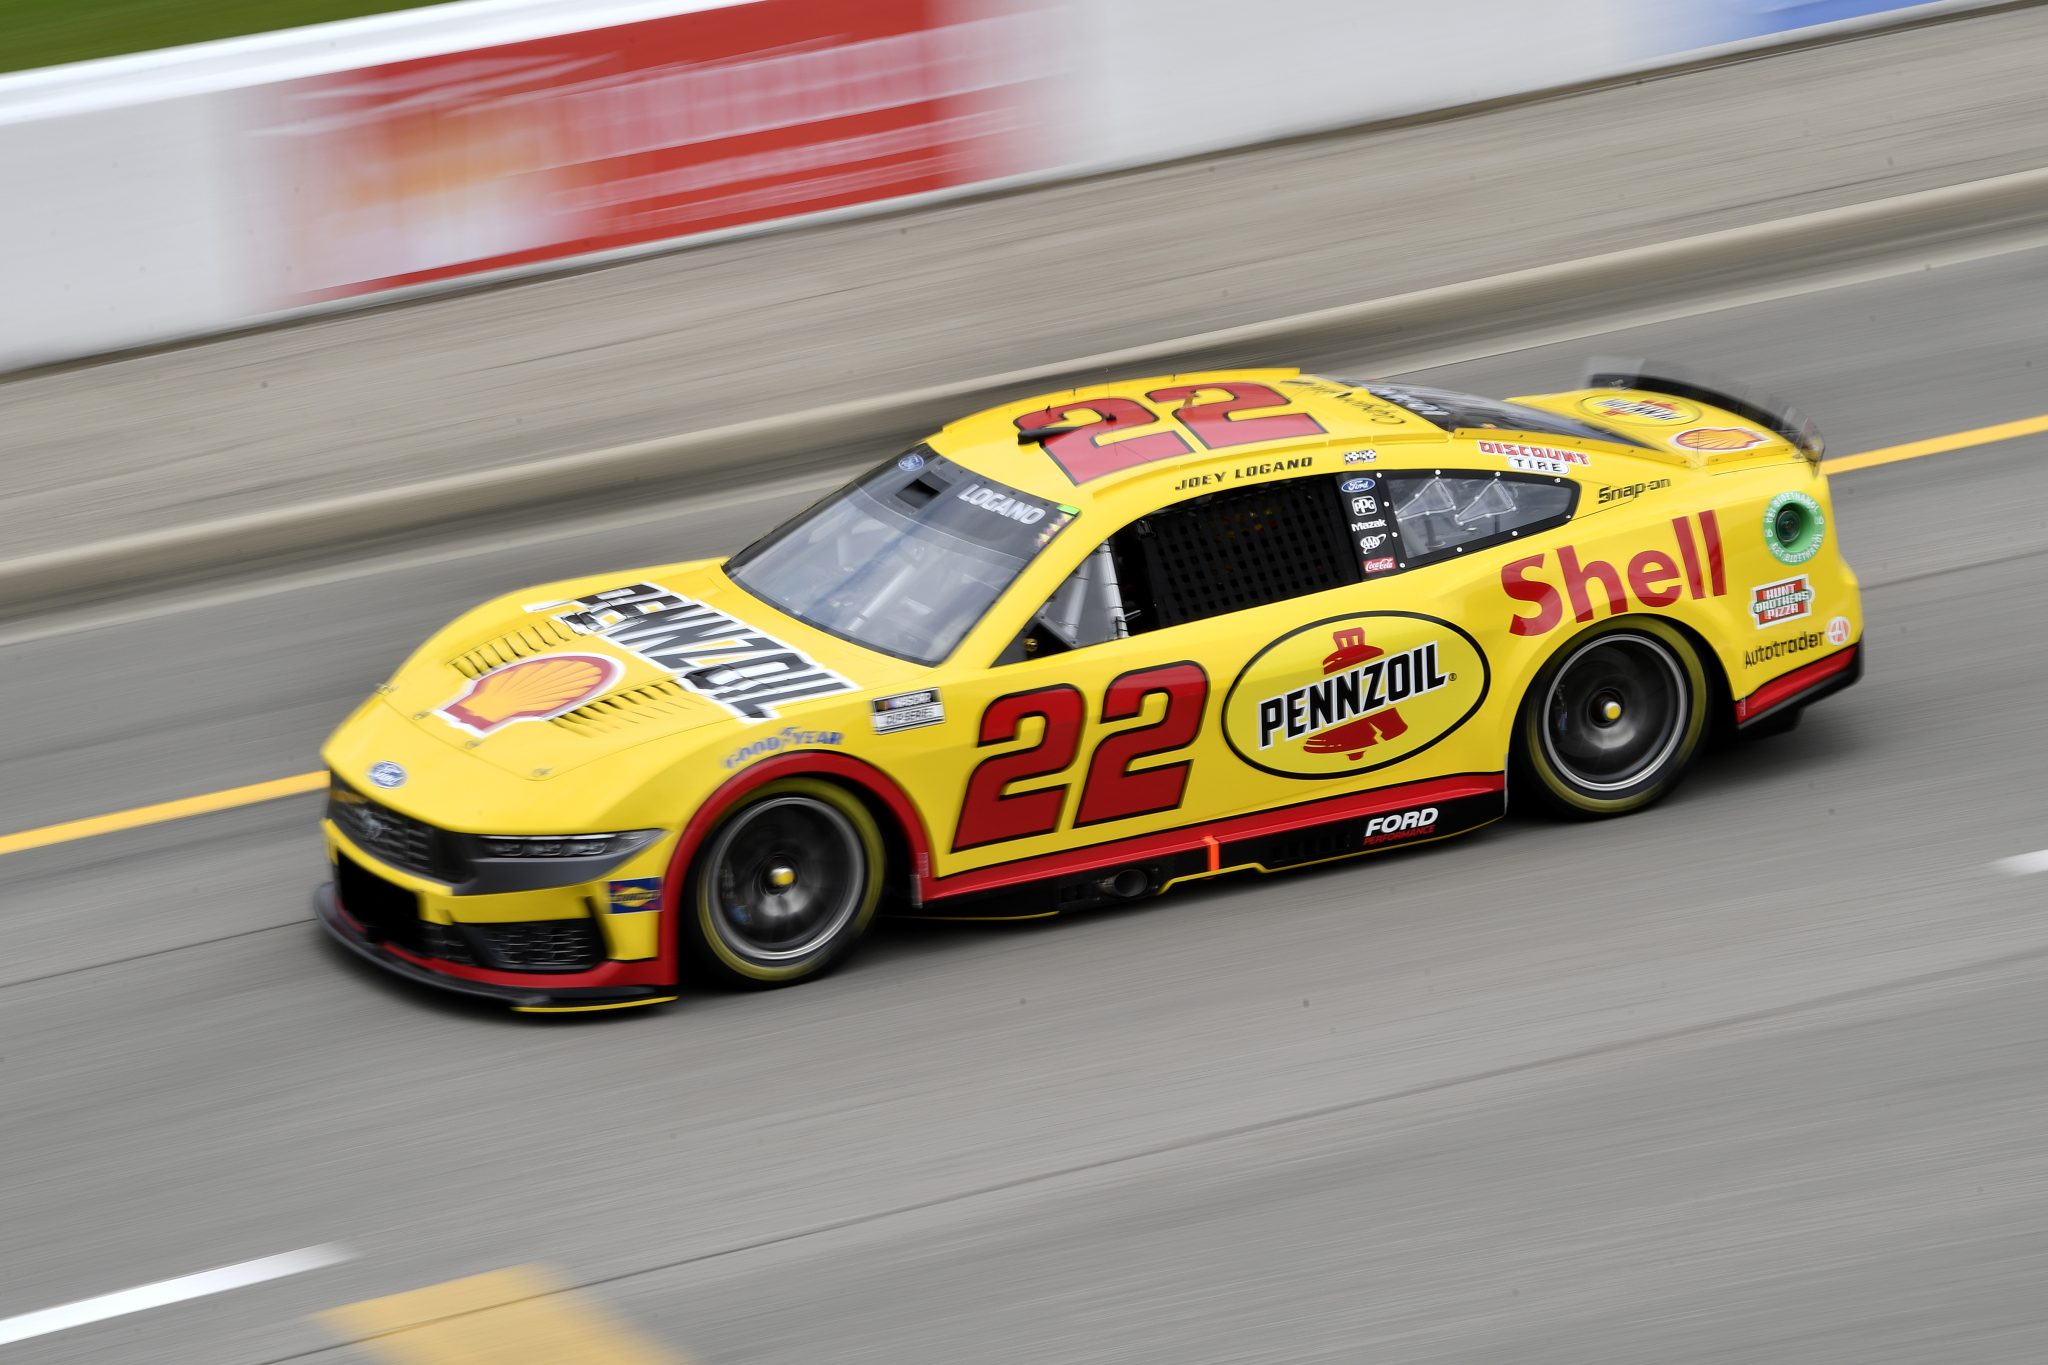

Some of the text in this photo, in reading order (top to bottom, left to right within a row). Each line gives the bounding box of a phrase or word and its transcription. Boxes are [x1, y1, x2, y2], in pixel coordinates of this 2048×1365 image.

[1013, 382, 1329, 487] 22
[1479, 441, 1589, 466] DISCOUNT
[1514, 458, 1563, 472] TIRE
[1175, 457, 1313, 491] JOEY LOGANO
[957, 483, 1046, 525] LOGANO
[1598, 478, 1671, 505] Snap-on
[1354, 498, 1376, 514] PPG
[1351, 518, 1387, 532] Mazak
[1365, 558, 1394, 573] Coca-Cola
[1502, 509, 1727, 637] Shell
[1756, 591, 1809, 613] BROTHERS
[1766, 584, 1796, 600] HUNT
[1766, 603, 1798, 620] PIZZA
[555, 582, 862, 722] PENNZOIL
[1745, 631, 1825, 669] Autotrader
[1259, 641, 1449, 749] PENNZOIL
[950, 660, 1210, 855] 22
[1363, 824, 1436, 845] PERFORMANCE
[1364, 807, 1439, 837] FORD
